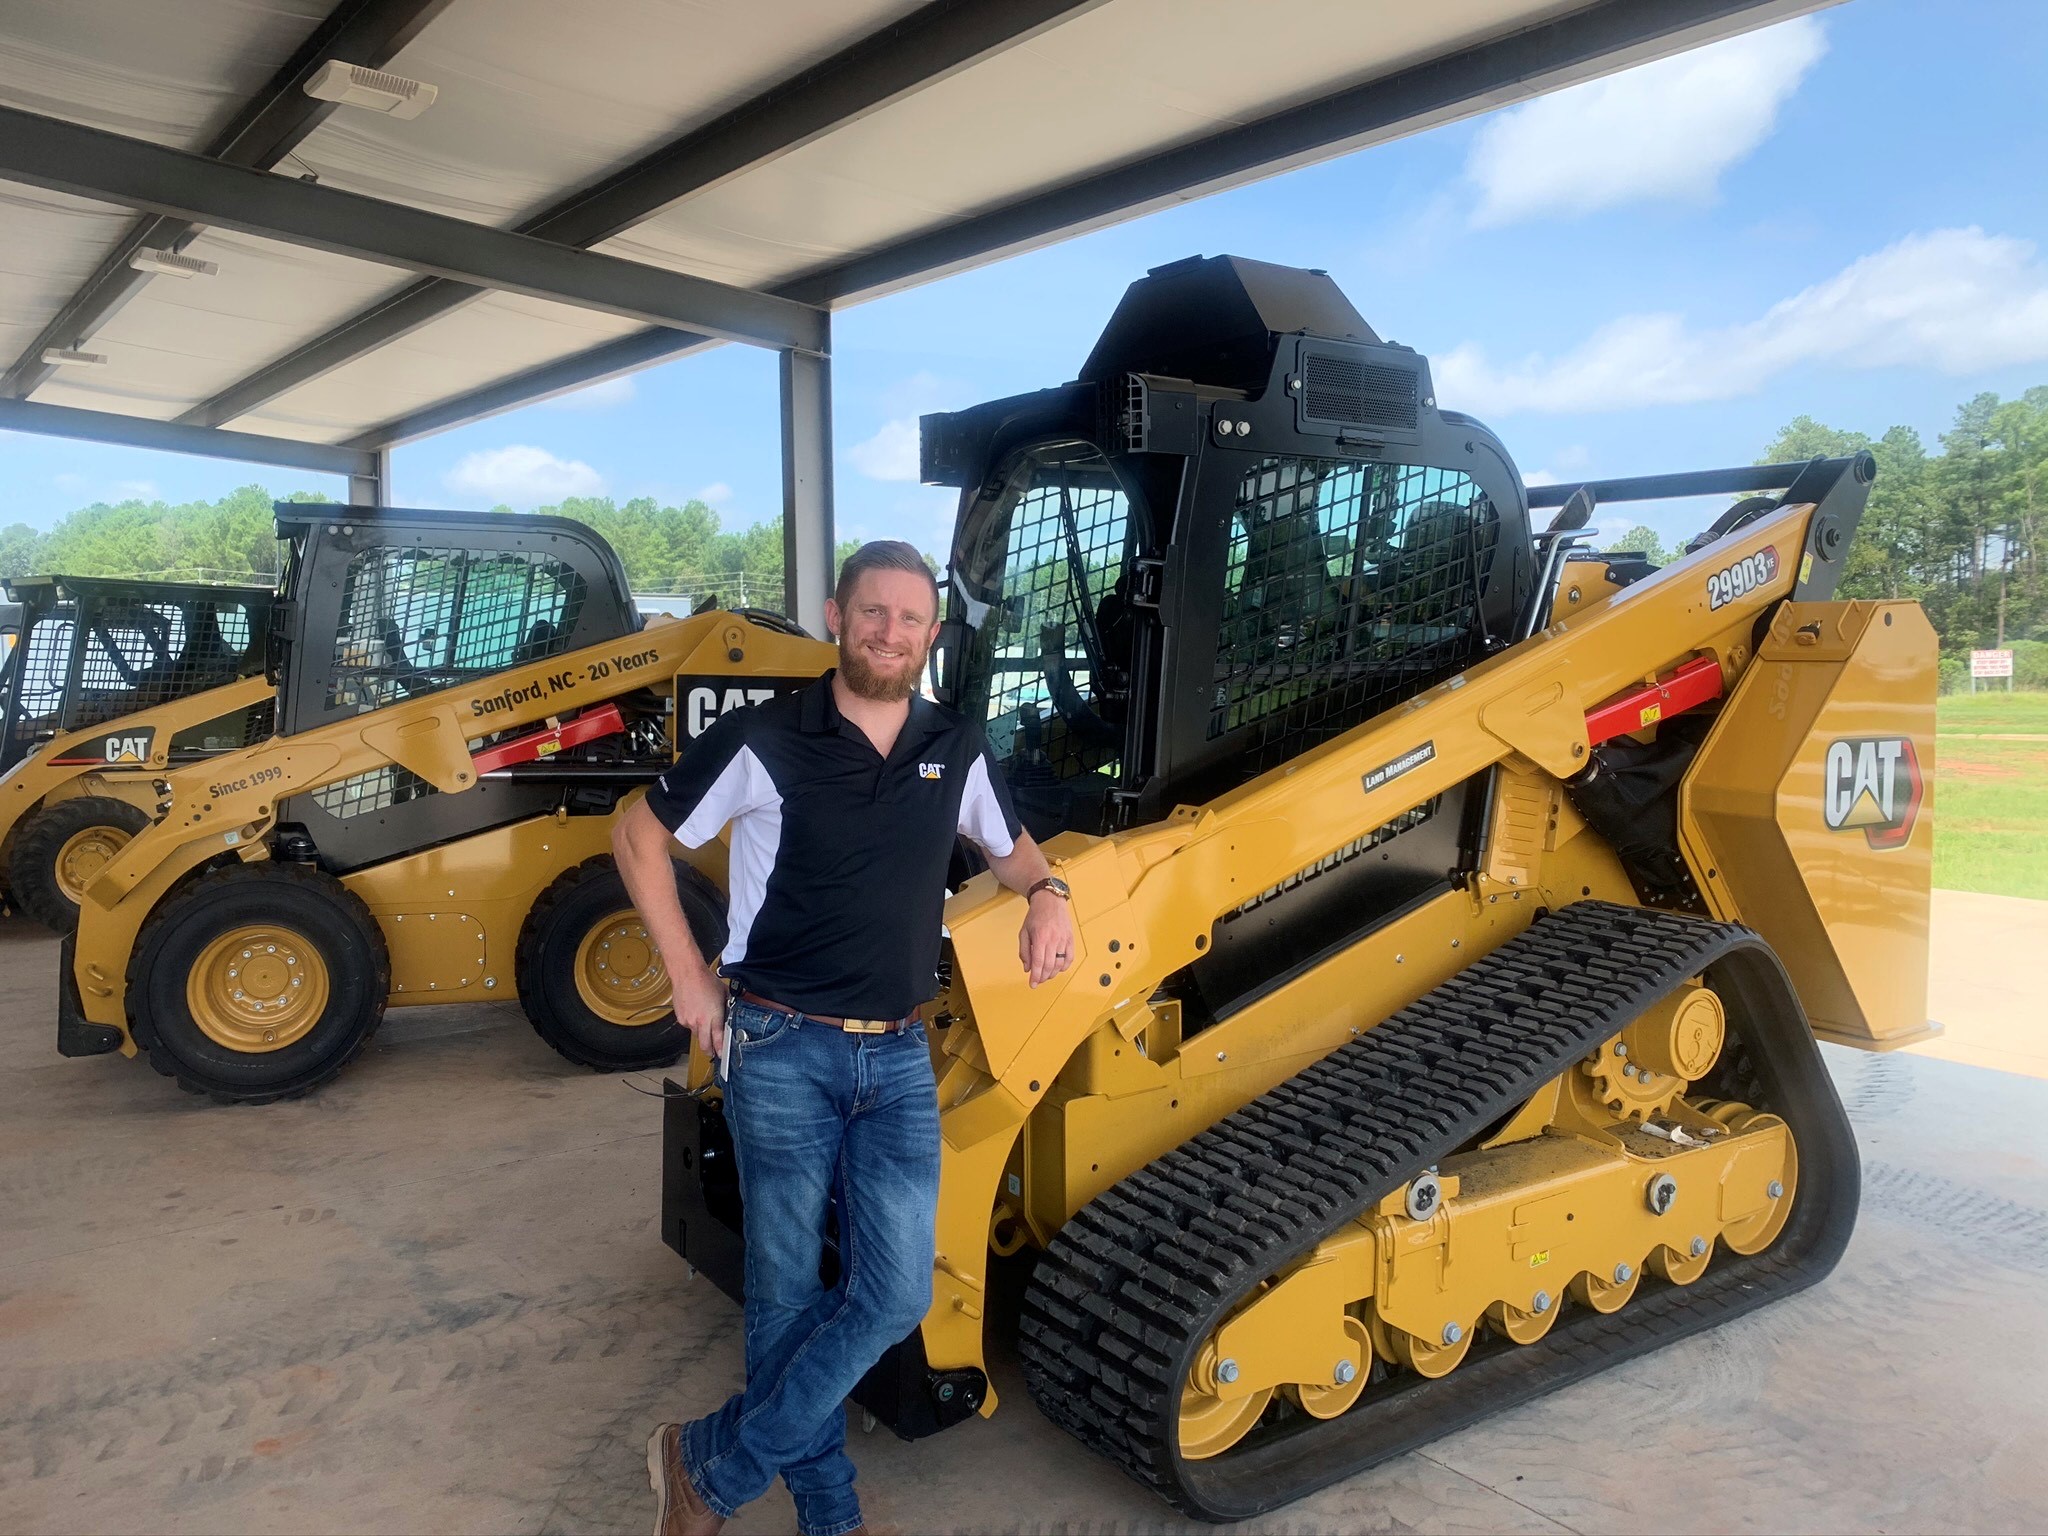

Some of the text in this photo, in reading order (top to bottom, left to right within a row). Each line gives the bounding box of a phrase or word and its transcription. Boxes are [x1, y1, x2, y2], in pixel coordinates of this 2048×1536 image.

[1708, 551, 1767, 610] 299D3
[471, 681, 547, 717] Sanford,
[548, 671, 576, 693] NC
[587, 661, 610, 681] 20
[611, 649, 659, 673] Years
[106, 737, 148, 763] CAT
[1366, 745, 1432, 789] LAND MANAGEMENT
[209, 766, 282, 799] Since 1999
[1826, 740, 1902, 828] CAT
